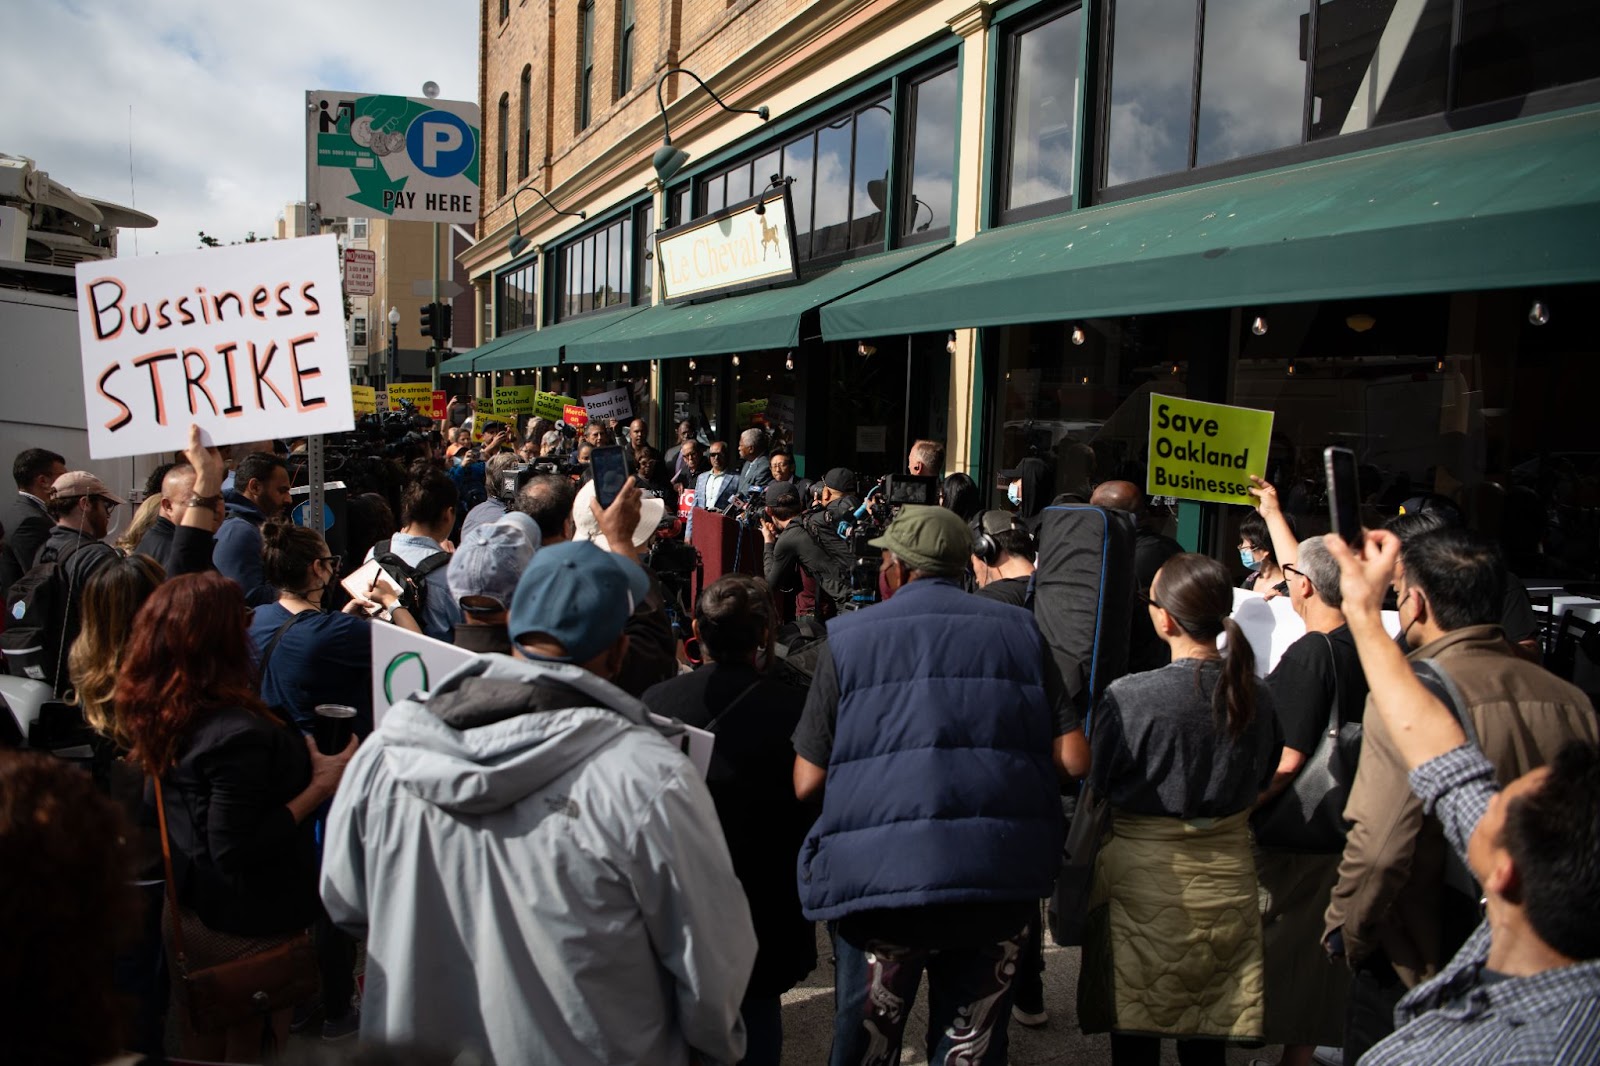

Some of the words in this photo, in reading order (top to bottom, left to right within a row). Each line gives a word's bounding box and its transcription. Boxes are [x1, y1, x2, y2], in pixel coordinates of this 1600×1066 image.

[422, 121, 463, 168] P
[382, 190, 416, 210] PAY
[426, 193, 472, 213] HERE
[346, 251, 355, 260] NO
[355, 252, 375, 261] PARKING
[667, 248, 691, 286] Le
[692, 221, 760, 279] Cheval
[85, 276, 321, 341] Bussiness
[95, 332, 328, 433] STRIKE
[388, 386, 406, 394] Safe
[495, 389, 519, 398] Save
[478, 400, 494, 408] Sav
[495, 396, 530, 405] Oakland
[537, 393, 560, 404] Save
[587, 397, 613, 410] Stand
[615, 395, 627, 403] for
[536, 400, 564, 412] Oaklan
[565, 407, 588, 417] Merch
[589, 410, 614, 420] Small
[616, 407, 629, 416] Biz
[1157, 403, 1219, 437] Save
[1155, 437, 1249, 469] Oakland
